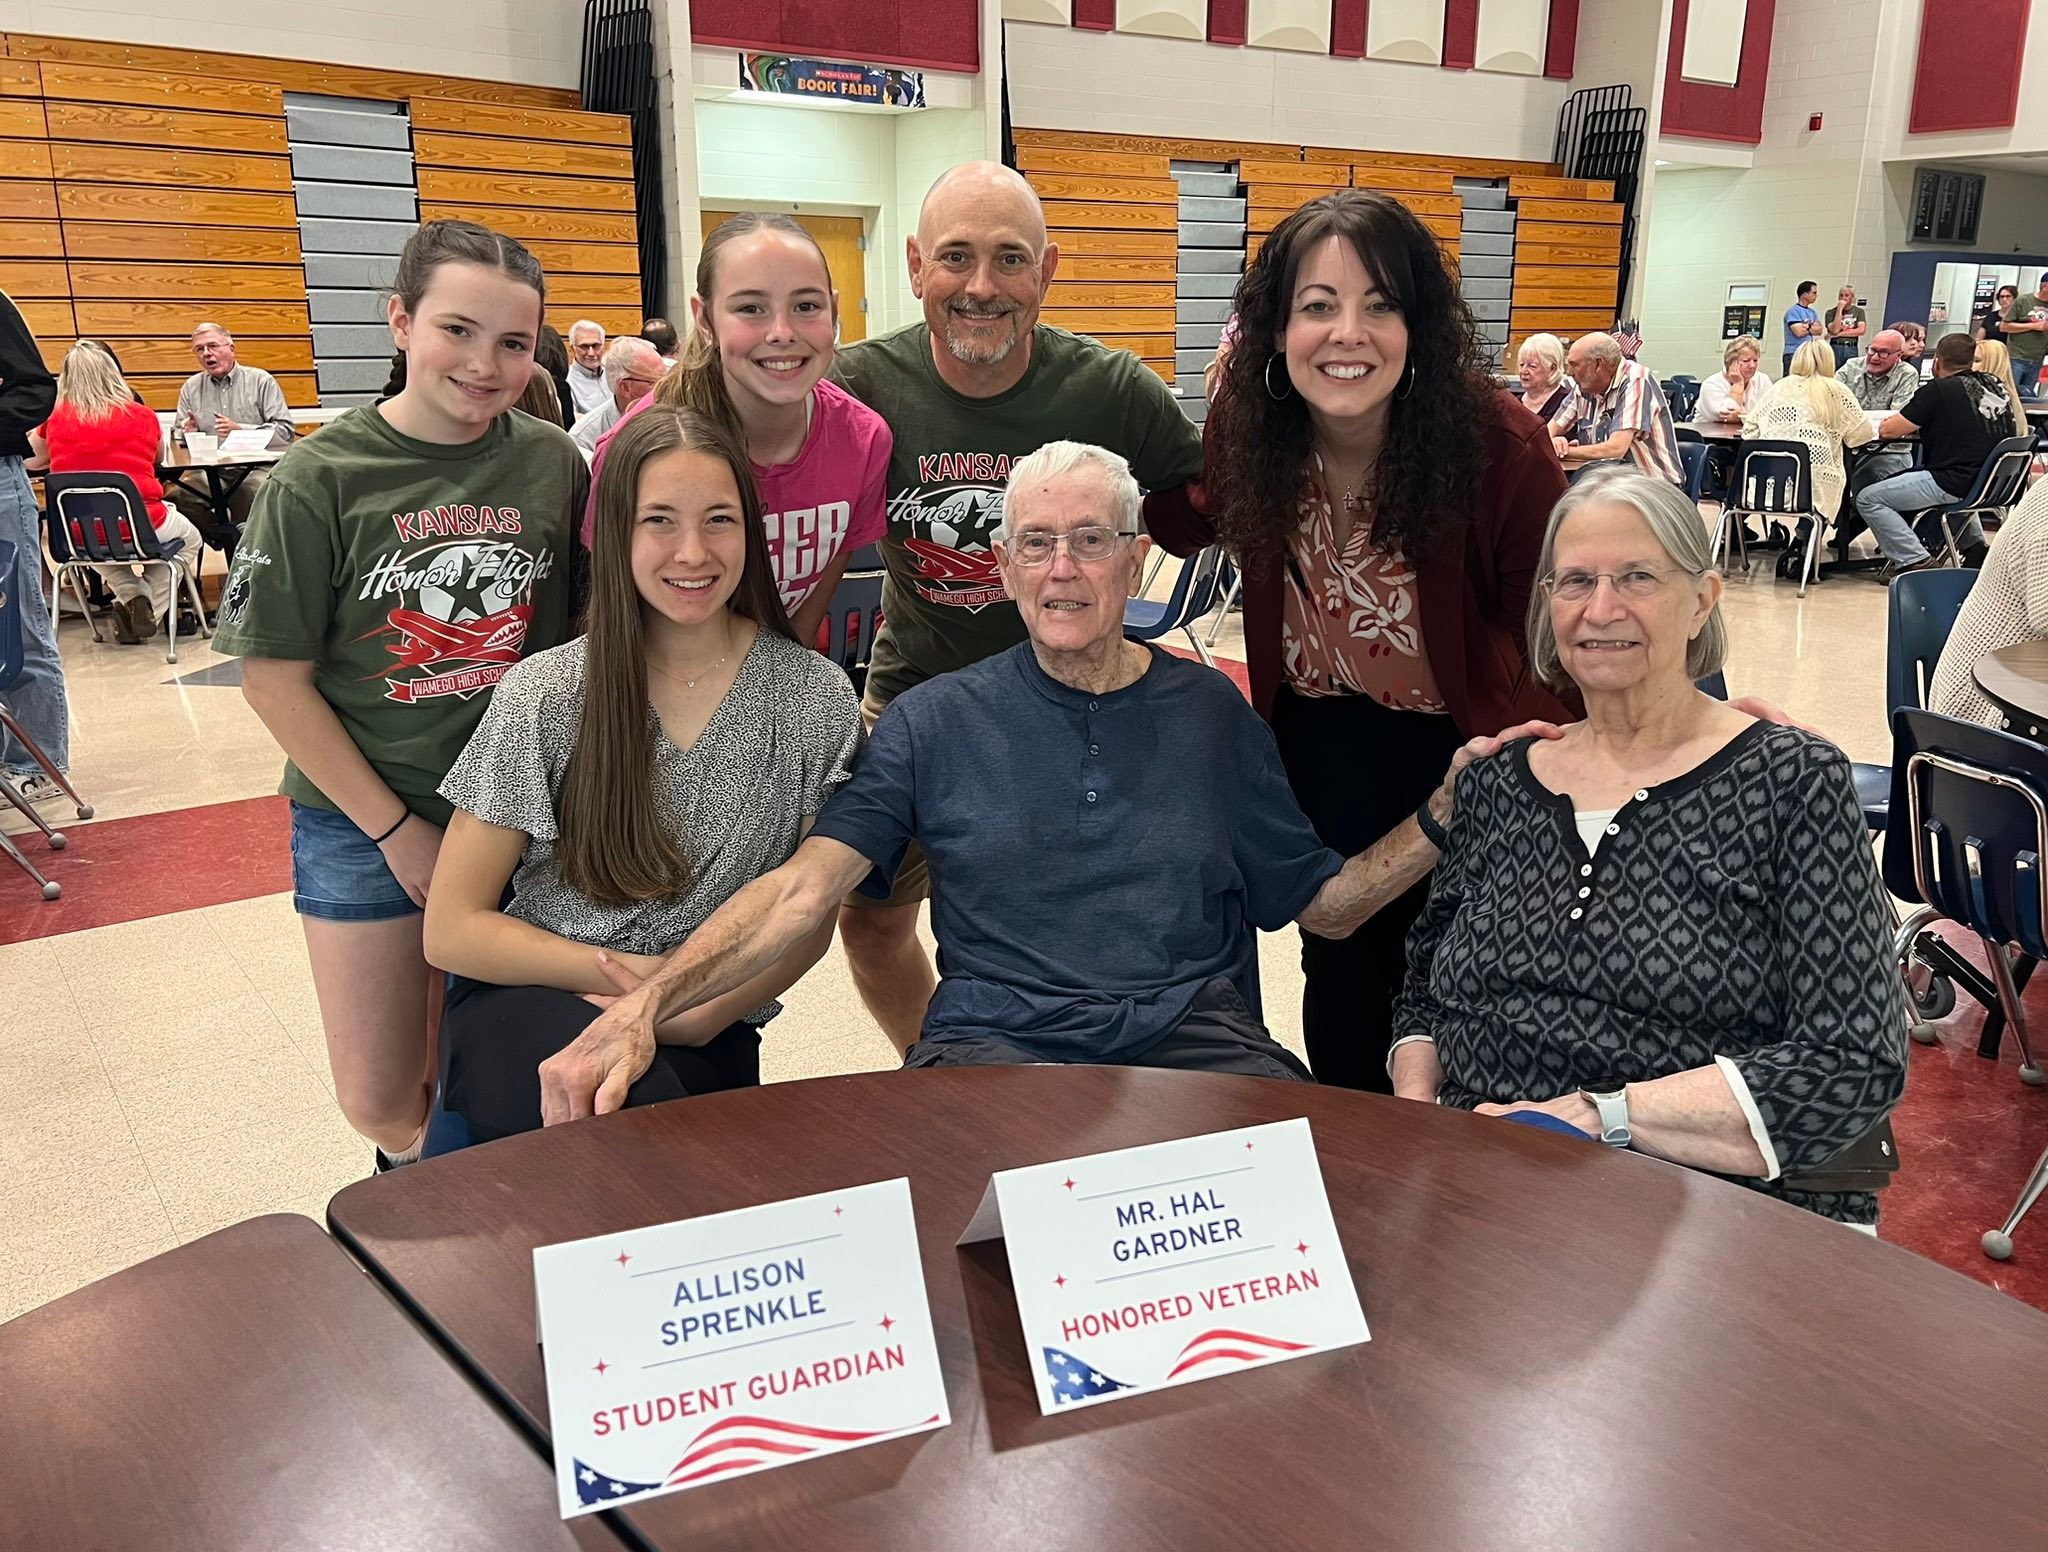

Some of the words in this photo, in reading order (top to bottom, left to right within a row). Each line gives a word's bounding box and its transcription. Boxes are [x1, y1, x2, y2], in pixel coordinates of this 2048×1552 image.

[797, 77, 837, 93] BOOK
[841, 82, 877, 96] FAIR!
[392, 504, 522, 542] KANSAS
[887, 487, 966, 524] Honor
[358, 549, 460, 600] Honor
[466, 542, 554, 598] Flight
[932, 592, 965, 604] WAMEGO
[966, 591, 986, 603] HIGH
[987, 590, 1008, 601] SCH
[413, 677, 455, 695] WAMEGO
[457, 670, 481, 688] HIGH
[482, 667, 509, 684] SCH
[1116, 1201, 1164, 1228] MR.
[1170, 1188, 1225, 1219] HAL
[1112, 1218, 1243, 1263] GARDNER
[673, 1257, 806, 1307] ALLISON
[661, 1289, 827, 1346] SPRENKLE
[1061, 1295, 1193, 1342] HONORED
[1199, 1267, 1320, 1312] VETERAN
[592, 1381, 738, 1436] STUDENT
[748, 1344, 905, 1400] GUARDIAN
